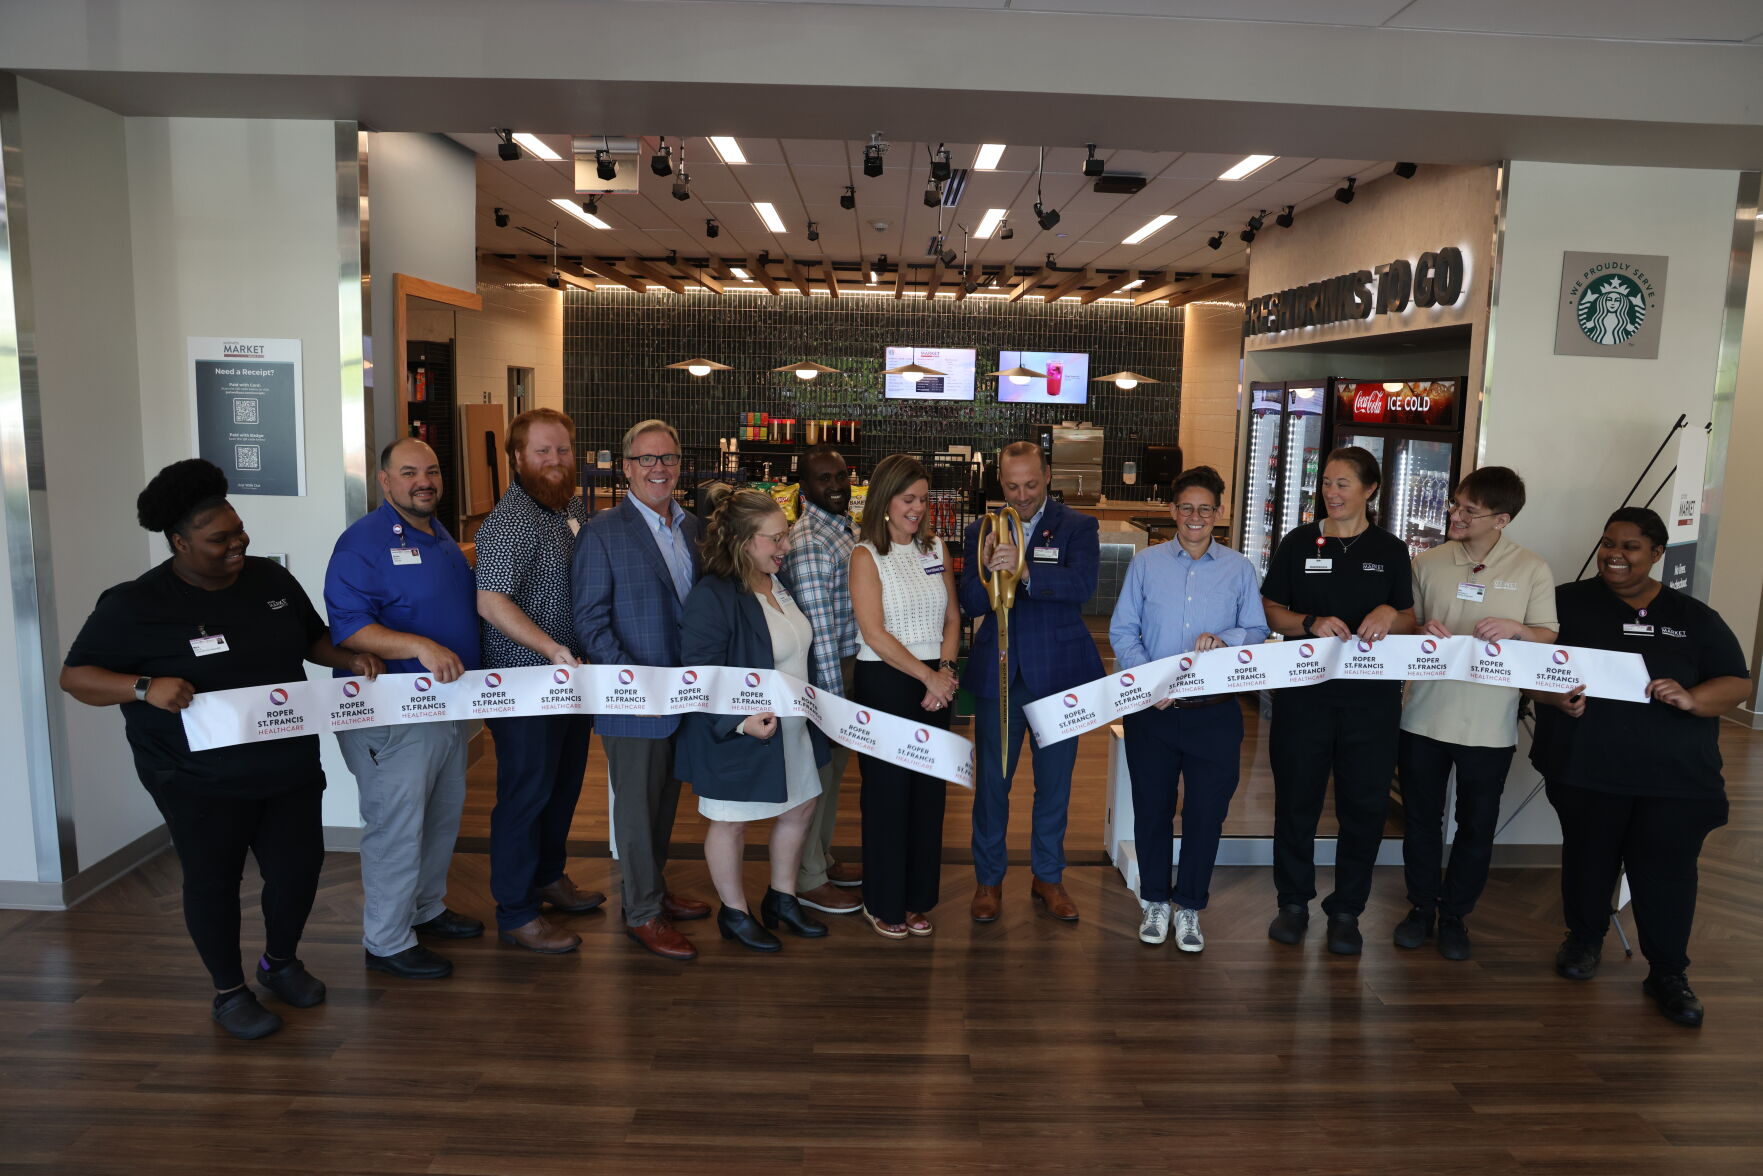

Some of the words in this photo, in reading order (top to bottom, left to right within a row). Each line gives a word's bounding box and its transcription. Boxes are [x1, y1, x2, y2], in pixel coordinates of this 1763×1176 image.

[1375, 259, 1411, 314] TO
[1414, 246, 1463, 308] GO
[1571, 280, 1582, 296] WE
[1584, 262, 1630, 279] PROUDLY
[1633, 269, 1655, 298] SERVE
[224, 345, 264, 354] MARKET
[1388, 396, 1402, 410] ICE
[1404, 396, 1430, 411] COLD
[1176, 673, 1195, 681] ROPER
[1470, 673, 1510, 682] HEALTHCARE
[1120, 687, 1141, 698] ROPER
[340, 701, 365, 709] ROPER
[1117, 700, 1151, 712] HEALTHCARE
[267, 709, 294, 717] ROPER
[1064, 709, 1086, 719] ROPER
[332, 716, 374, 726] HEALTHCARE
[259, 725, 304, 735] HEALTHCARE
[849, 724, 870, 736] ROPER
[1061, 719, 1097, 734] HEALTHCARE
[907, 744, 929, 754] ROPER
